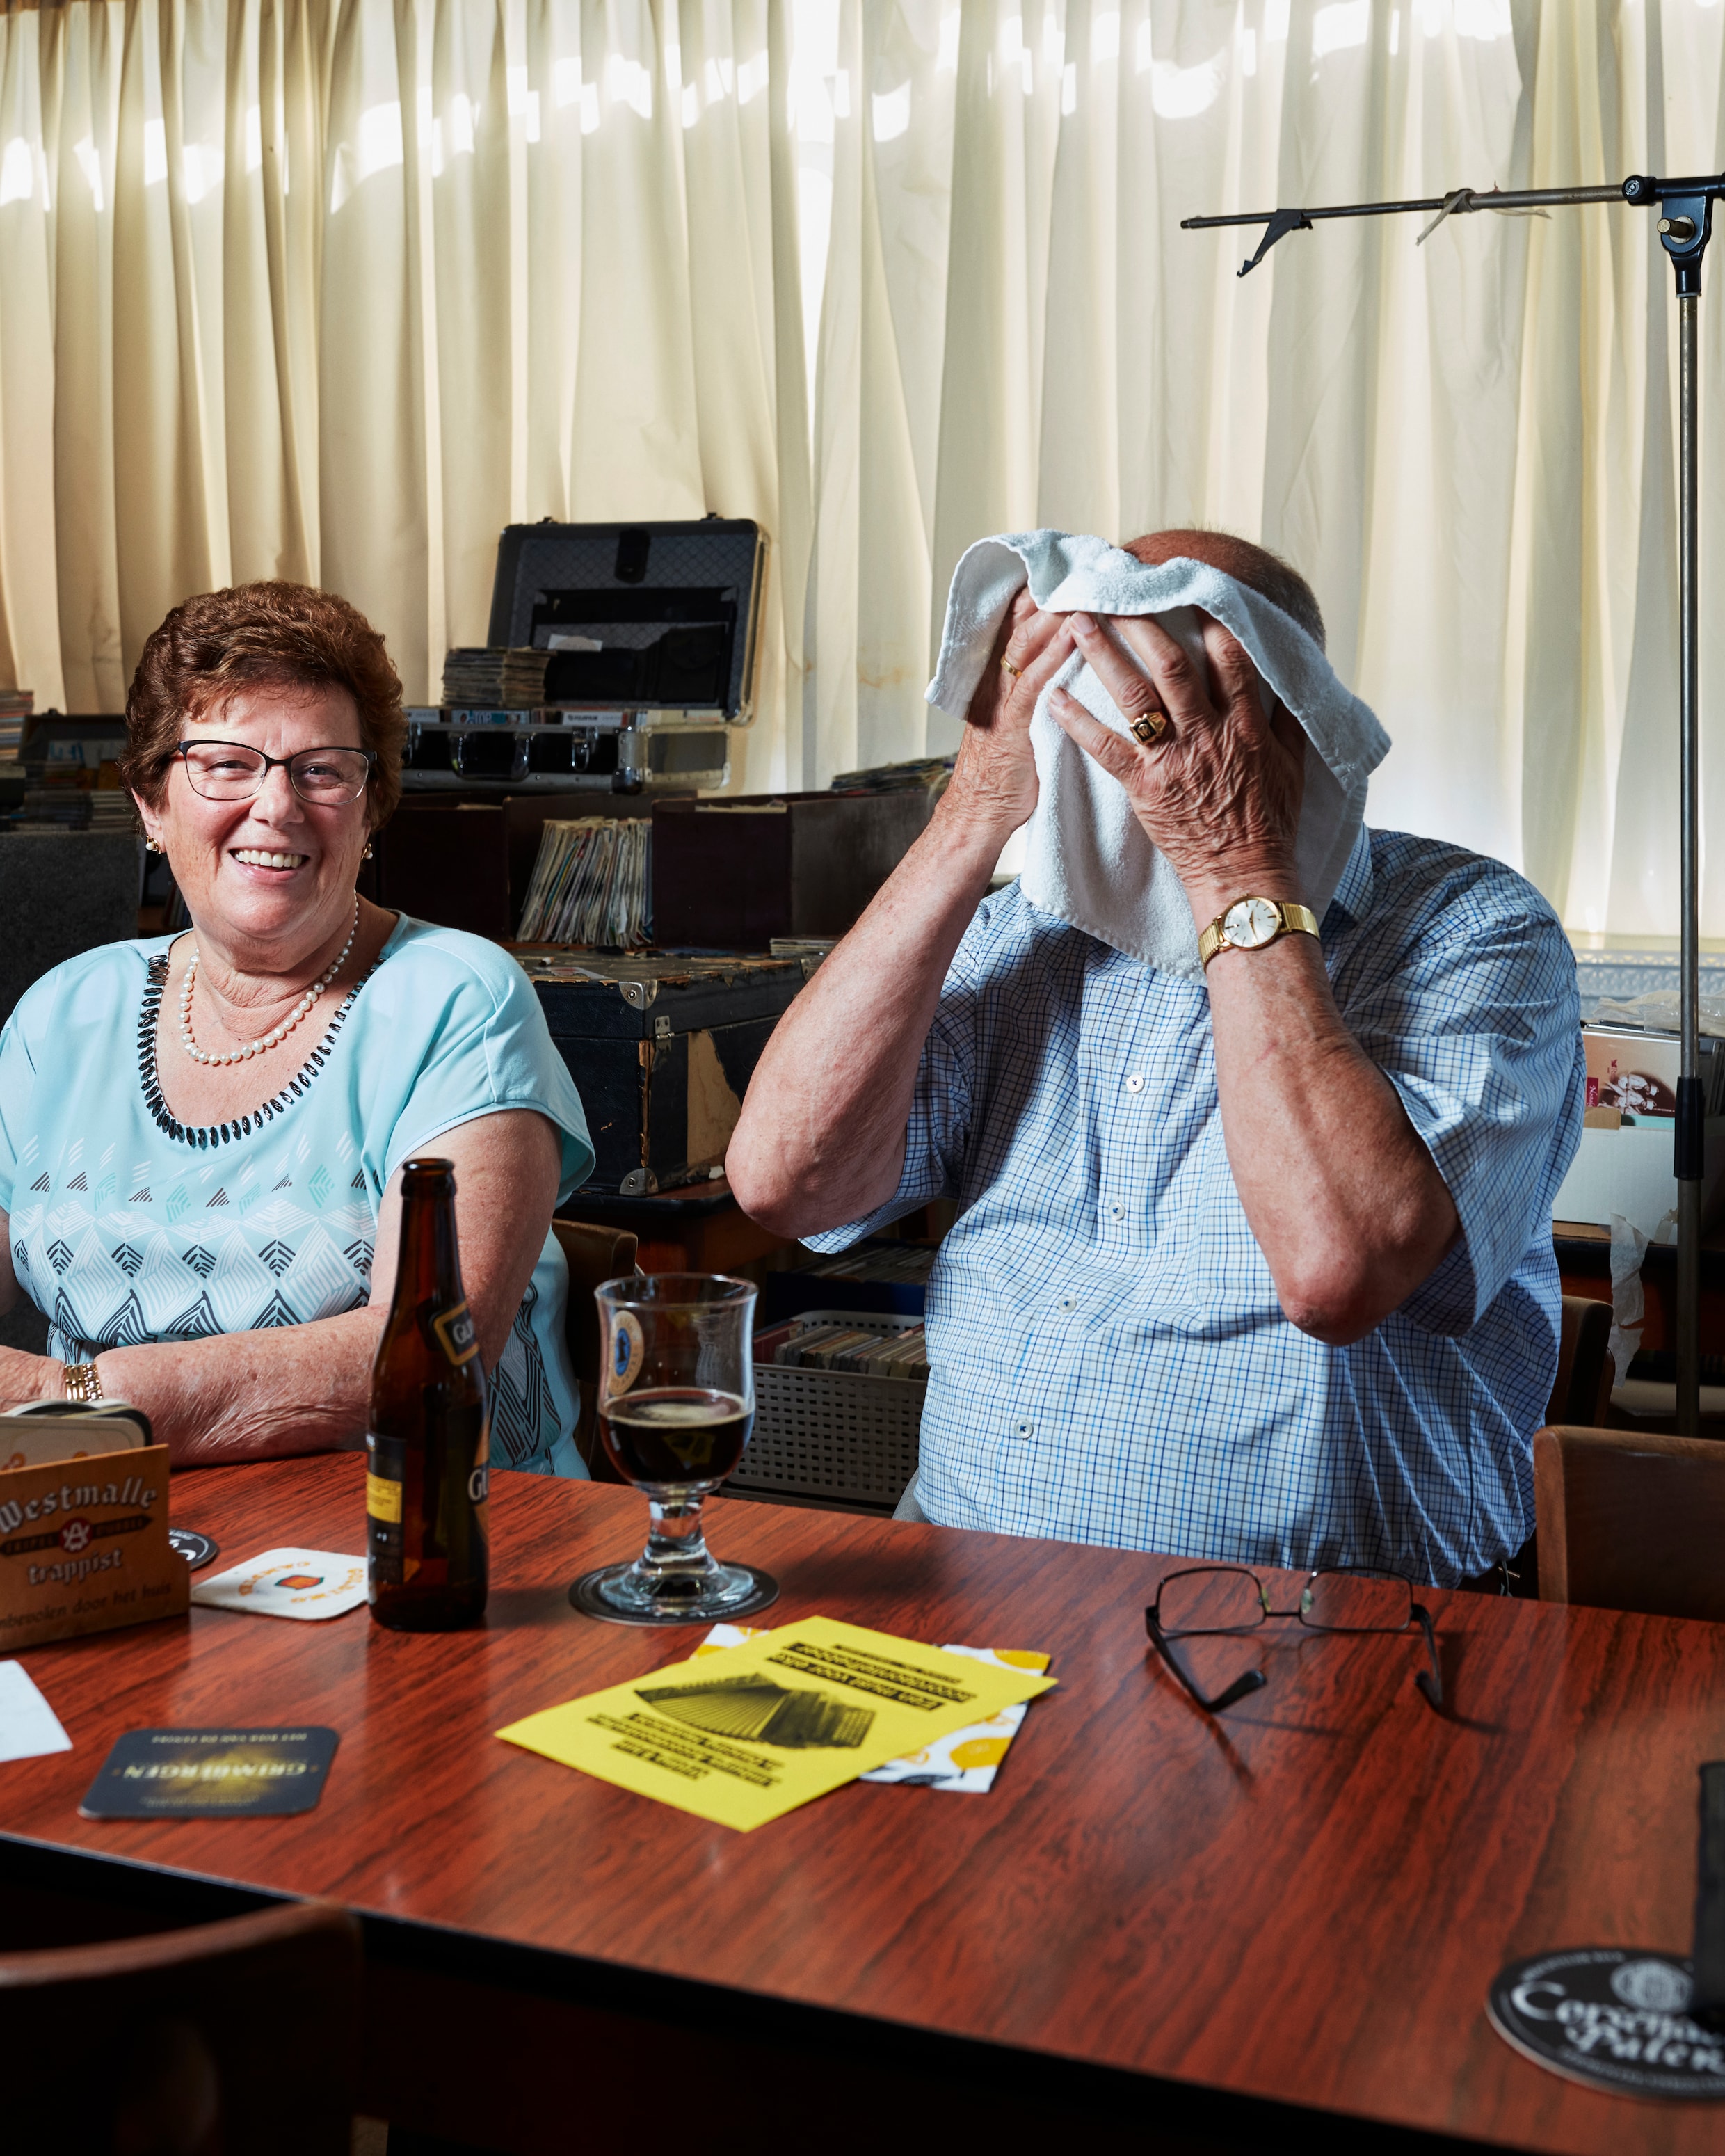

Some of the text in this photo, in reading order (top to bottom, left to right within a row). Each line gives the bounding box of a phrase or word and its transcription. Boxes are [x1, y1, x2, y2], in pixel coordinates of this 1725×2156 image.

[0, 1476, 157, 1532] Westmalle
[28, 1549, 123, 1586] trappist
[72, 1597, 107, 1615] door
[113, 1590, 137, 1604] het
[142, 1582, 172, 1599] huis
